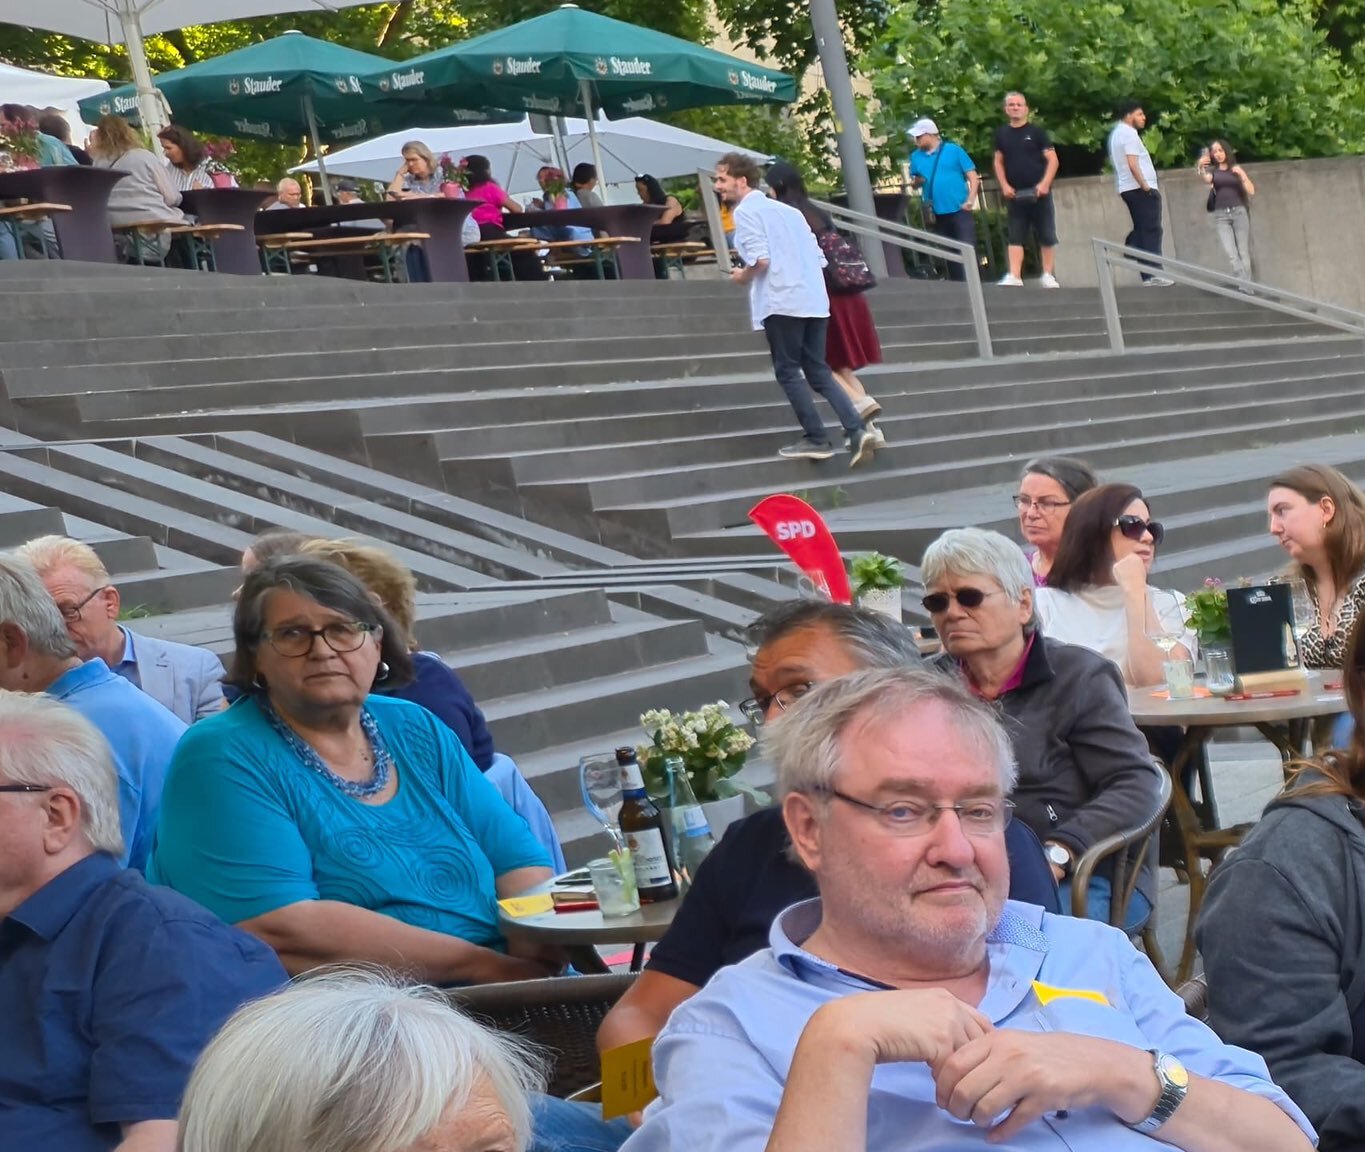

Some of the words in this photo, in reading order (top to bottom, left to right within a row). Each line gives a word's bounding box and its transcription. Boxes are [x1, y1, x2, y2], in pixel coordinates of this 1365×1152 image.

[507, 57, 542, 76] Stauder
[611, 56, 651, 76] Stauder
[244, 76, 283, 95] Stauder
[391, 69, 425, 90] Stauder
[742, 70, 778, 93] Stauder
[775, 520, 817, 540] SPD
